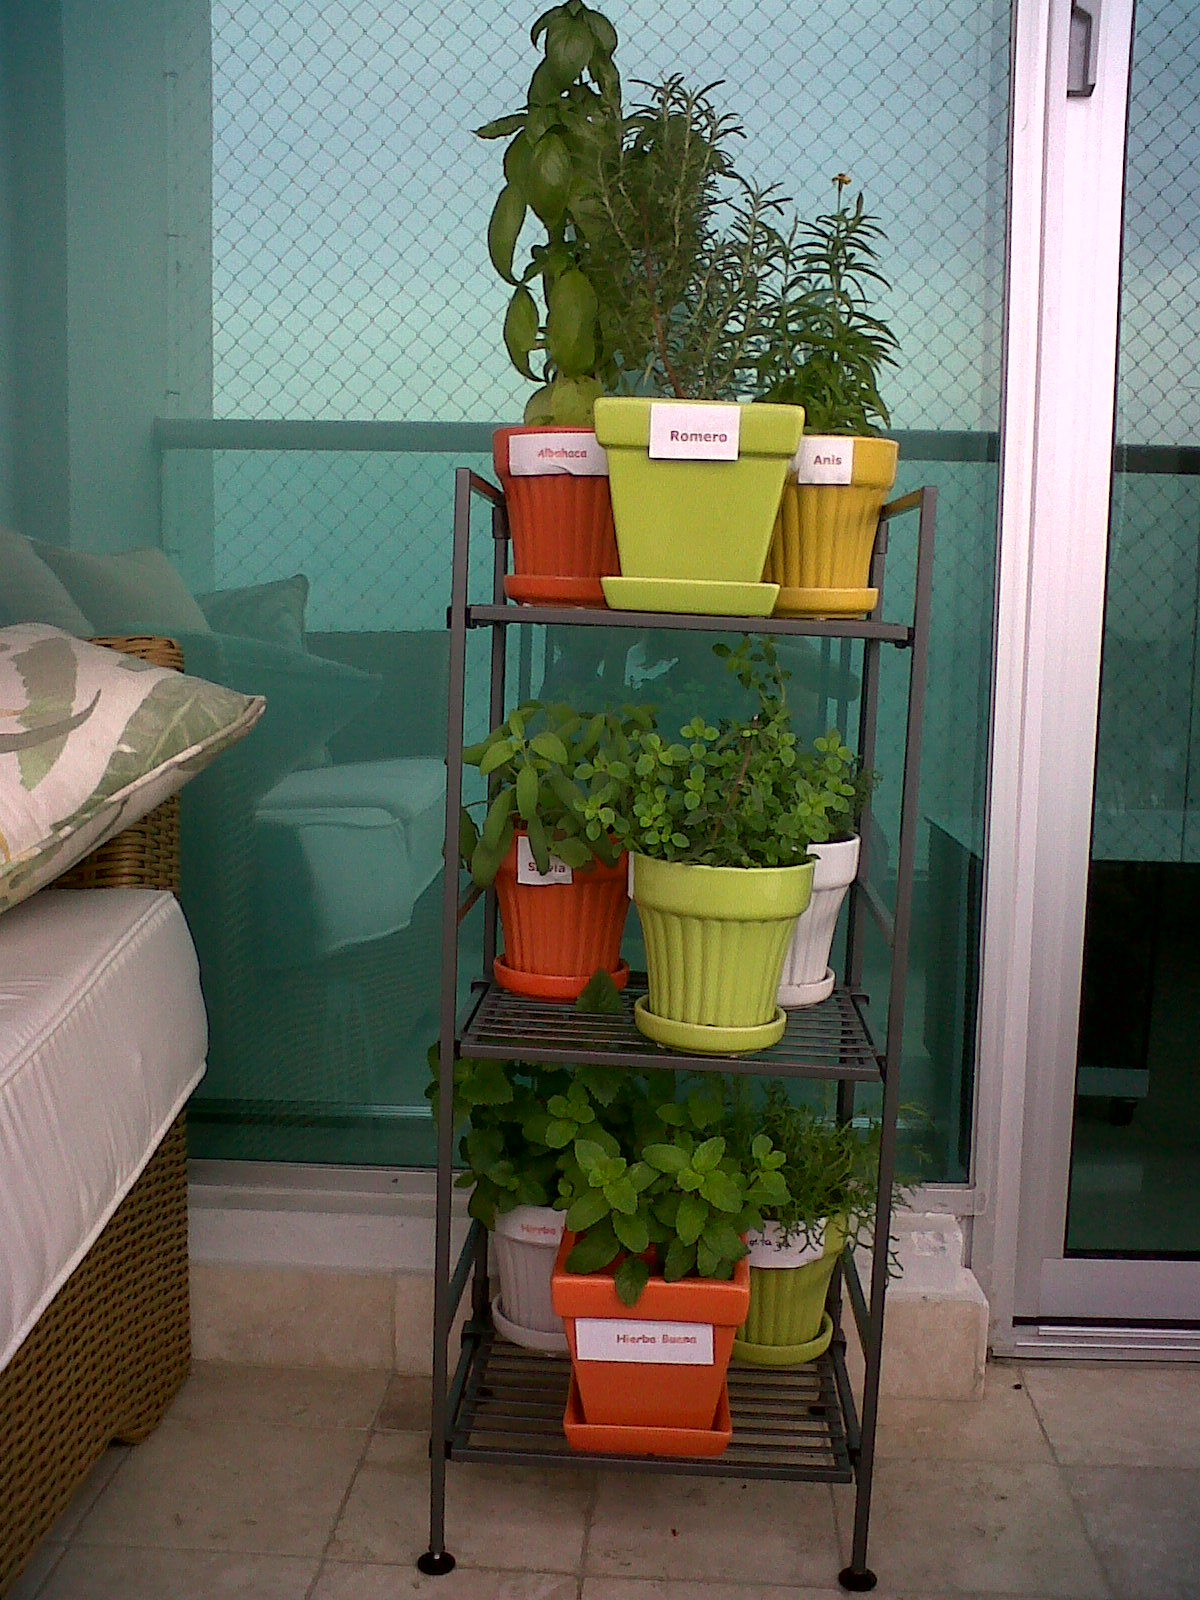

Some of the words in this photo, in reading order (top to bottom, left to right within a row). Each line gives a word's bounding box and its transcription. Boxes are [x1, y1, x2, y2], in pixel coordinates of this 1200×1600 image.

[669, 430, 728, 443] Romero
[813, 454, 843, 466] Anis
[527, 861, 566, 874] Svia
[616, 1333, 657, 1345] Hierba
